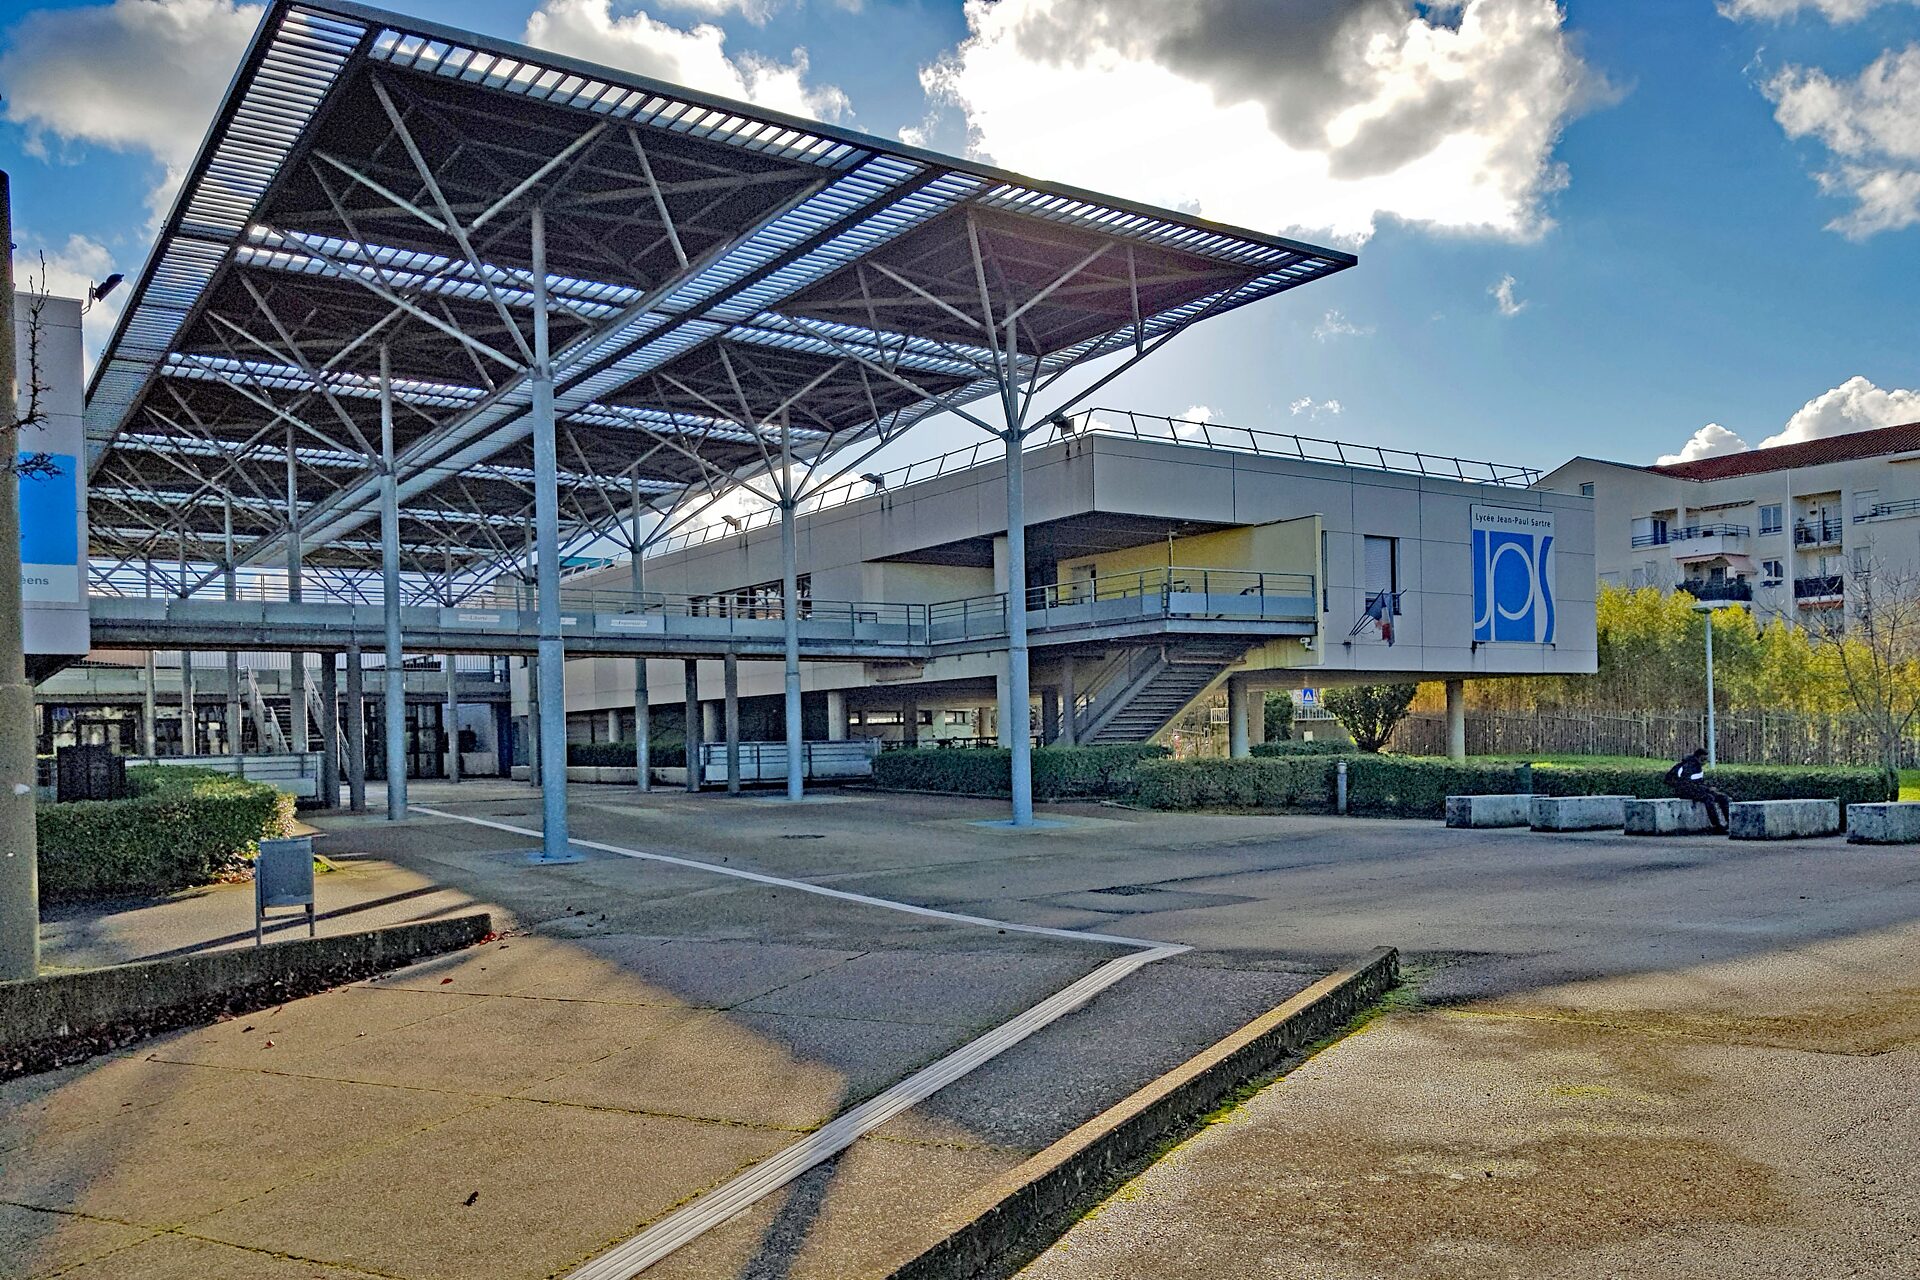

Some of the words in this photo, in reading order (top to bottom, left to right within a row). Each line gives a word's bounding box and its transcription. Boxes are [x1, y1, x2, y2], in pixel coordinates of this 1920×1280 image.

[1476, 513, 1494, 523] Lycée
[1497, 515, 1529, 525] Jean-Paul
[1531, 518, 1551, 528] Sartre
